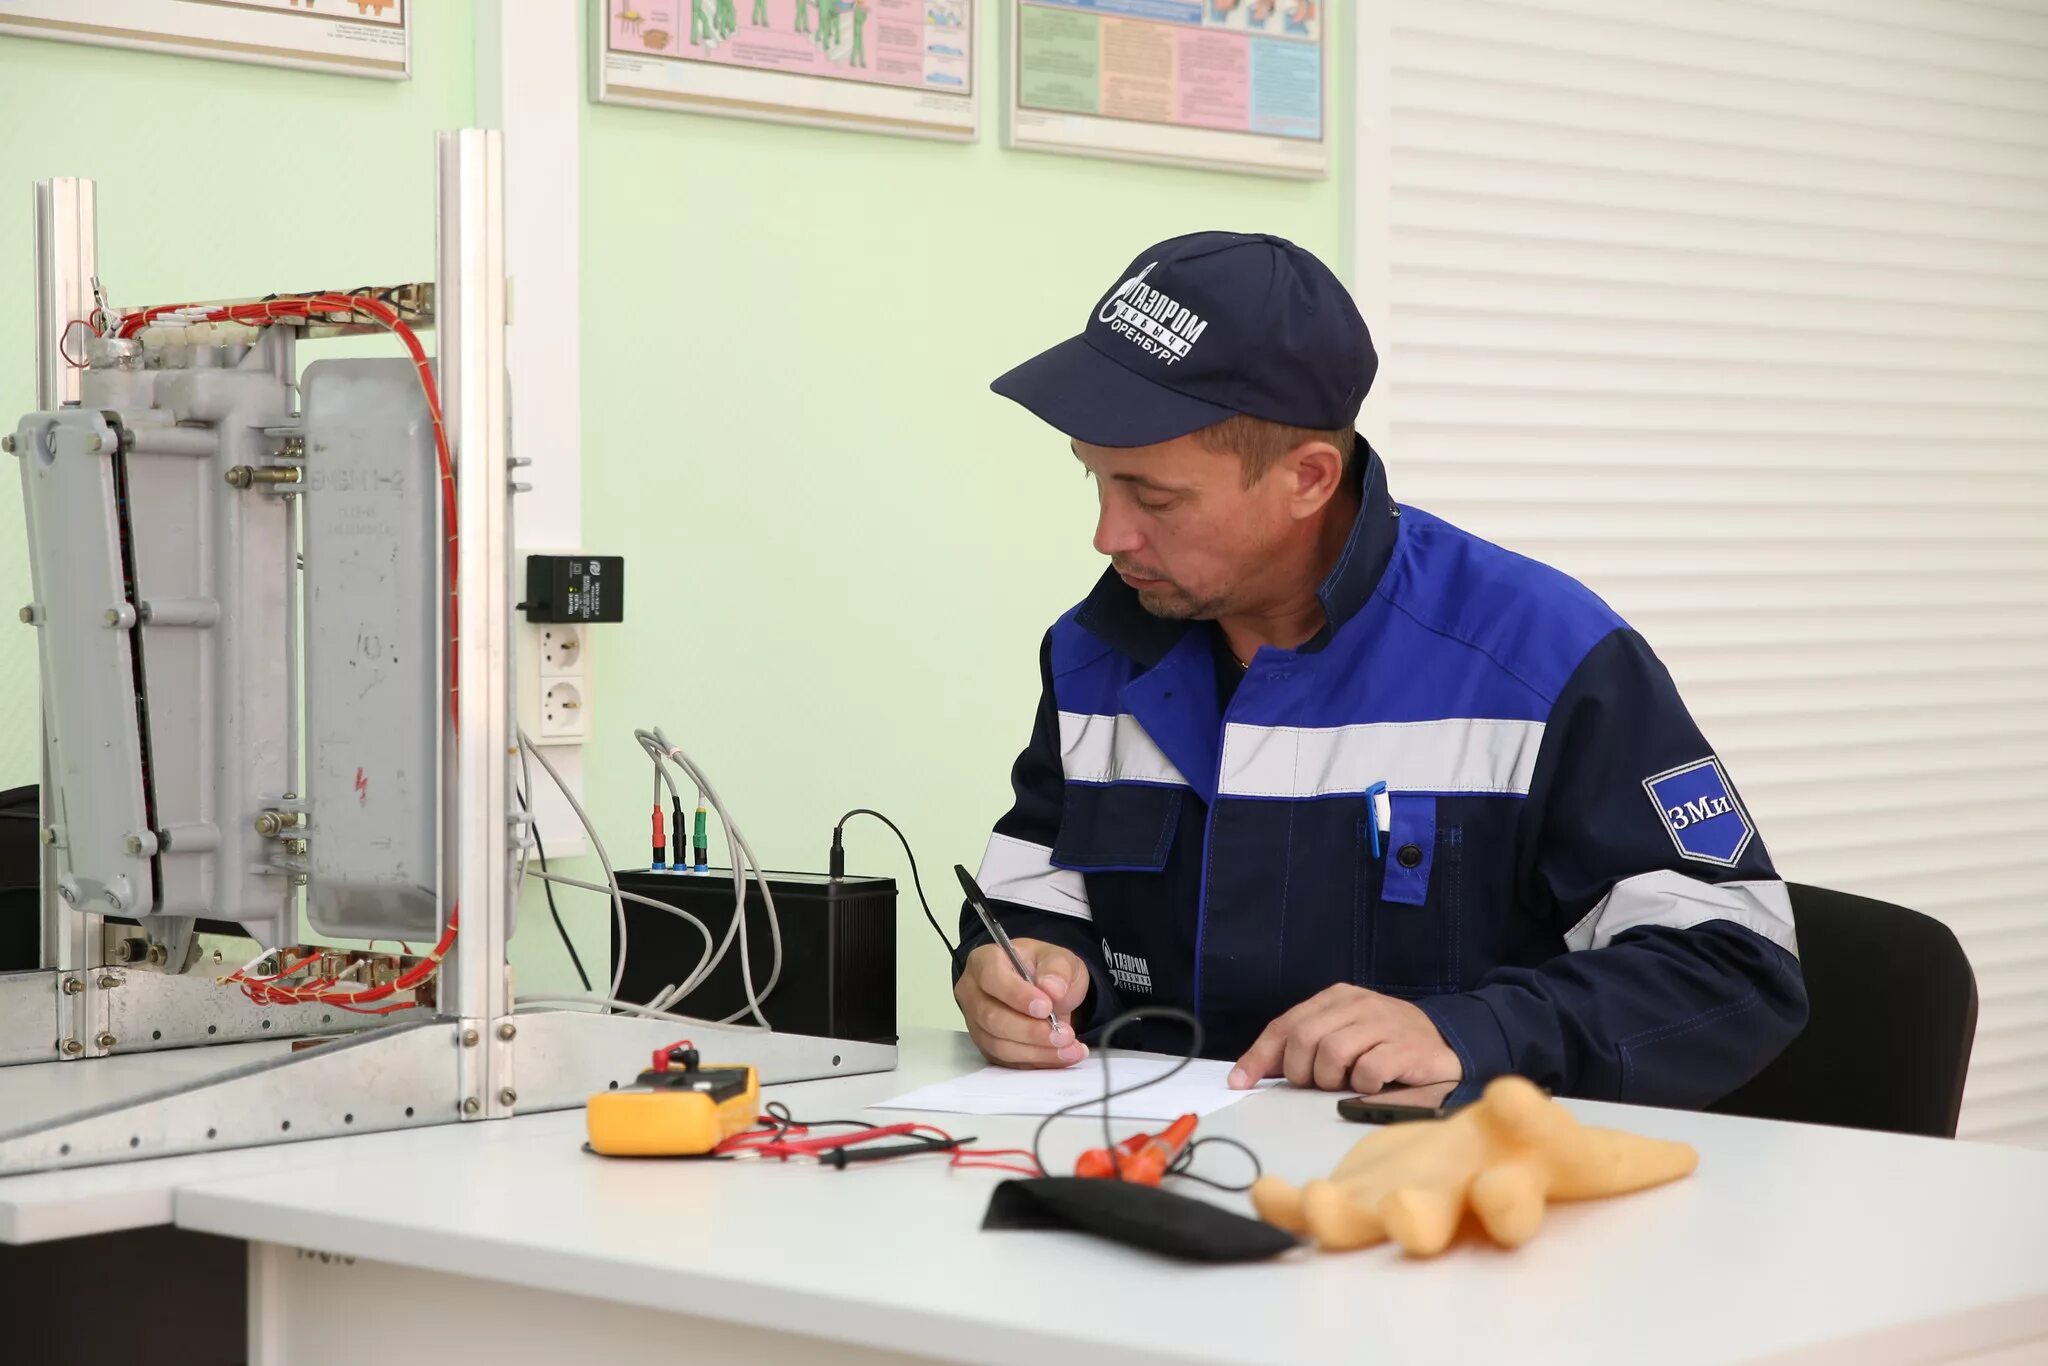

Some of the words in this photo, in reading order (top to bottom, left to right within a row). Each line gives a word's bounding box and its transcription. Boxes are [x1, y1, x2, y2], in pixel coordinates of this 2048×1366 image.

[1119, 306, 1189, 355] ДОБЫЧА
[1128, 281, 1209, 344] ГАЗПРОМ
[1111, 319, 1181, 366] ОРЕНБУРГ
